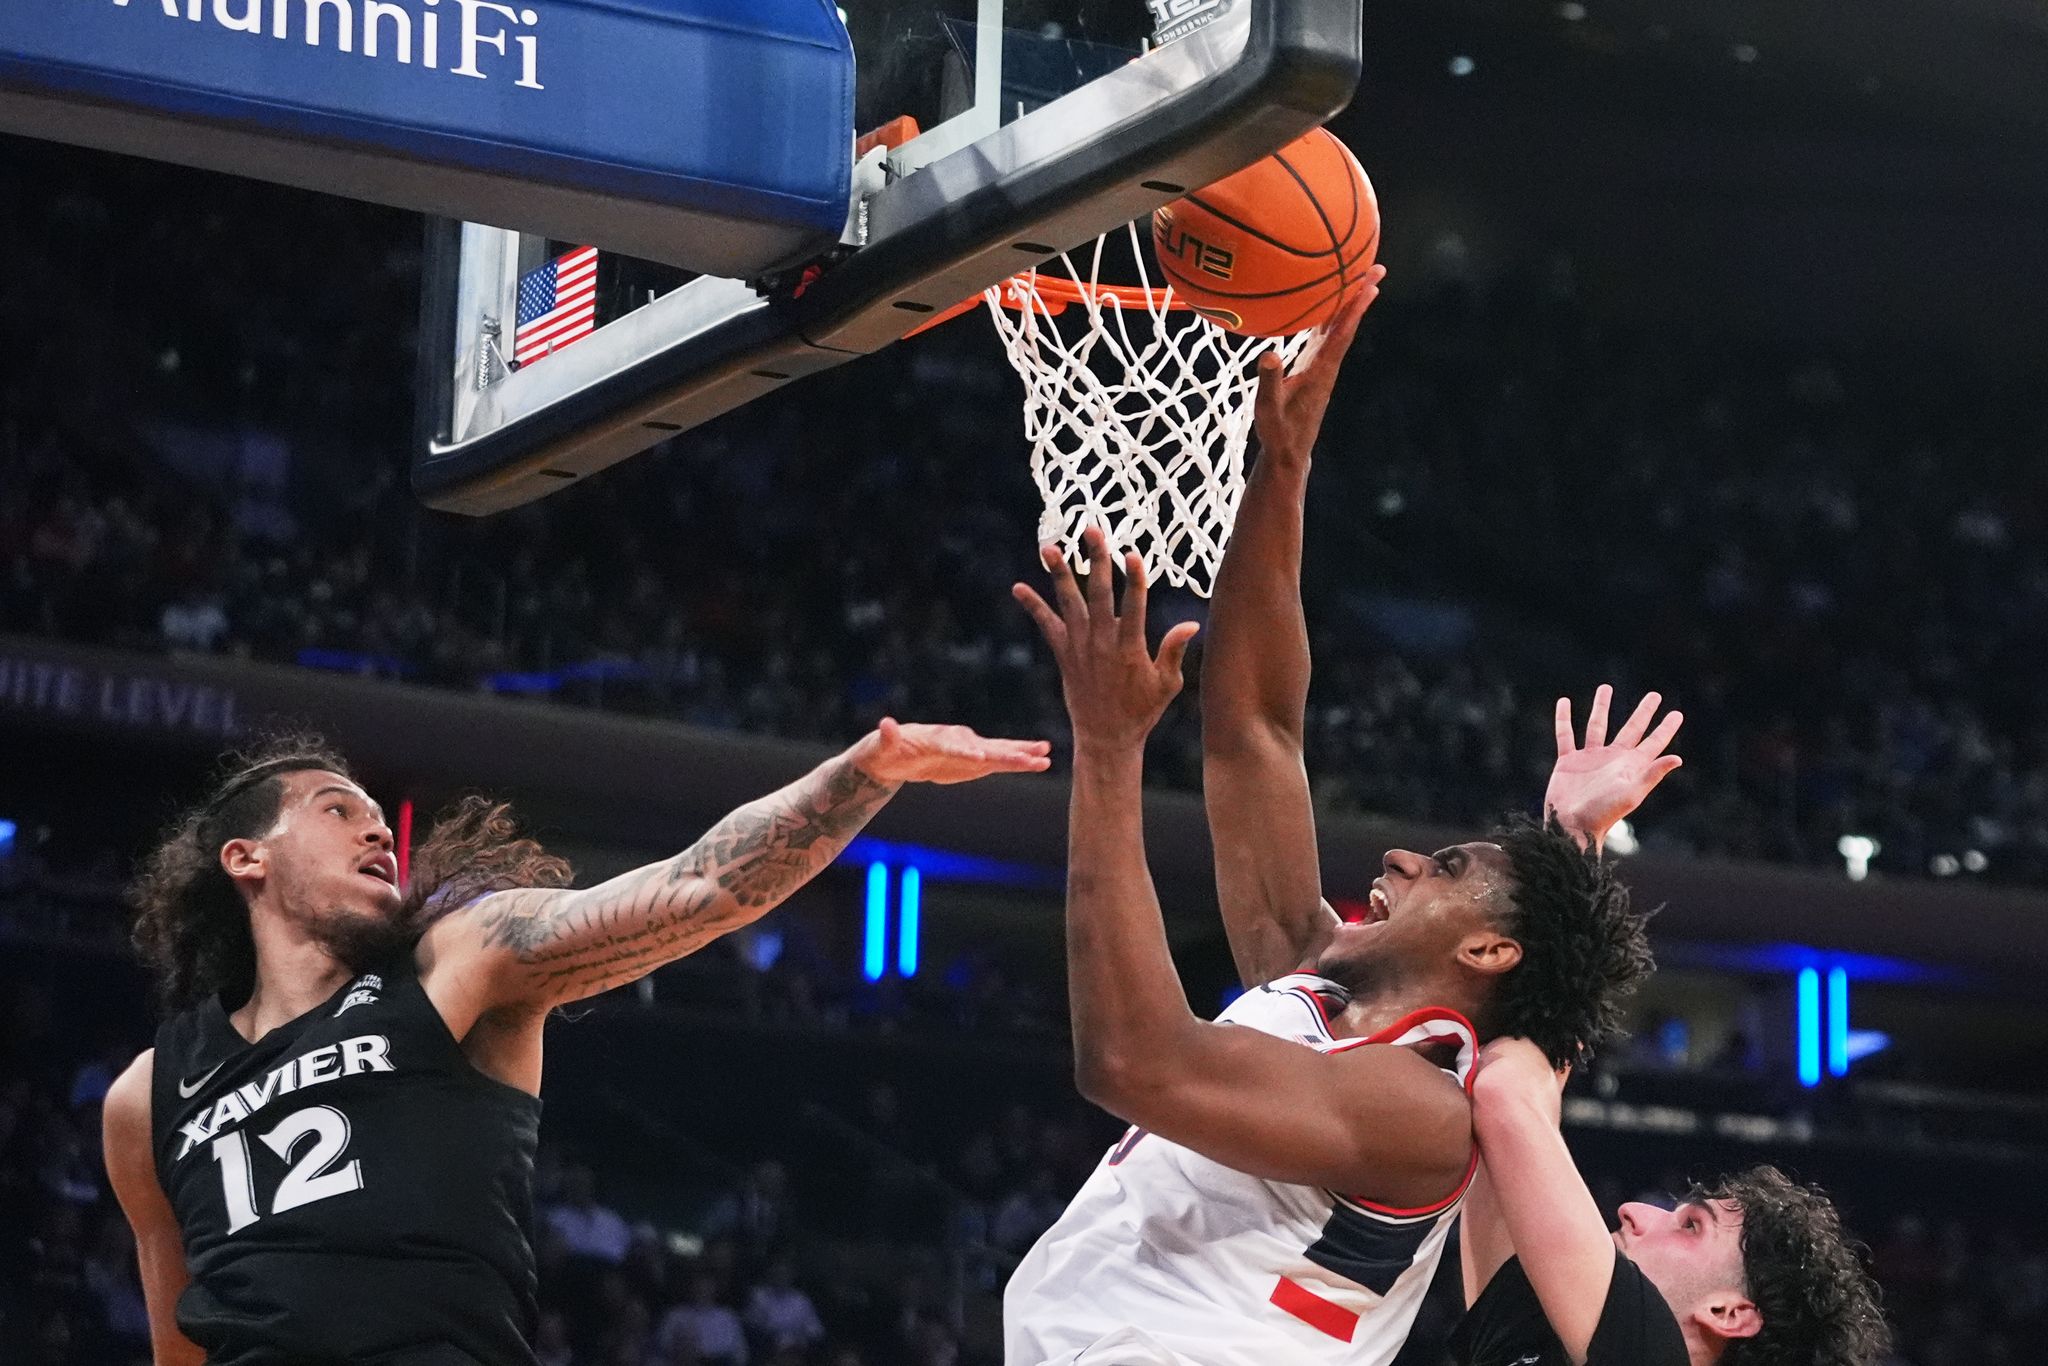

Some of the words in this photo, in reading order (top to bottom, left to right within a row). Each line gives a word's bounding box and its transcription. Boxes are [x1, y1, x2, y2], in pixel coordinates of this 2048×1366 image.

[101, 674, 241, 737] LEVEL
[176, 1034, 397, 1161] XAVIER
[211, 1104, 365, 1236] 12
